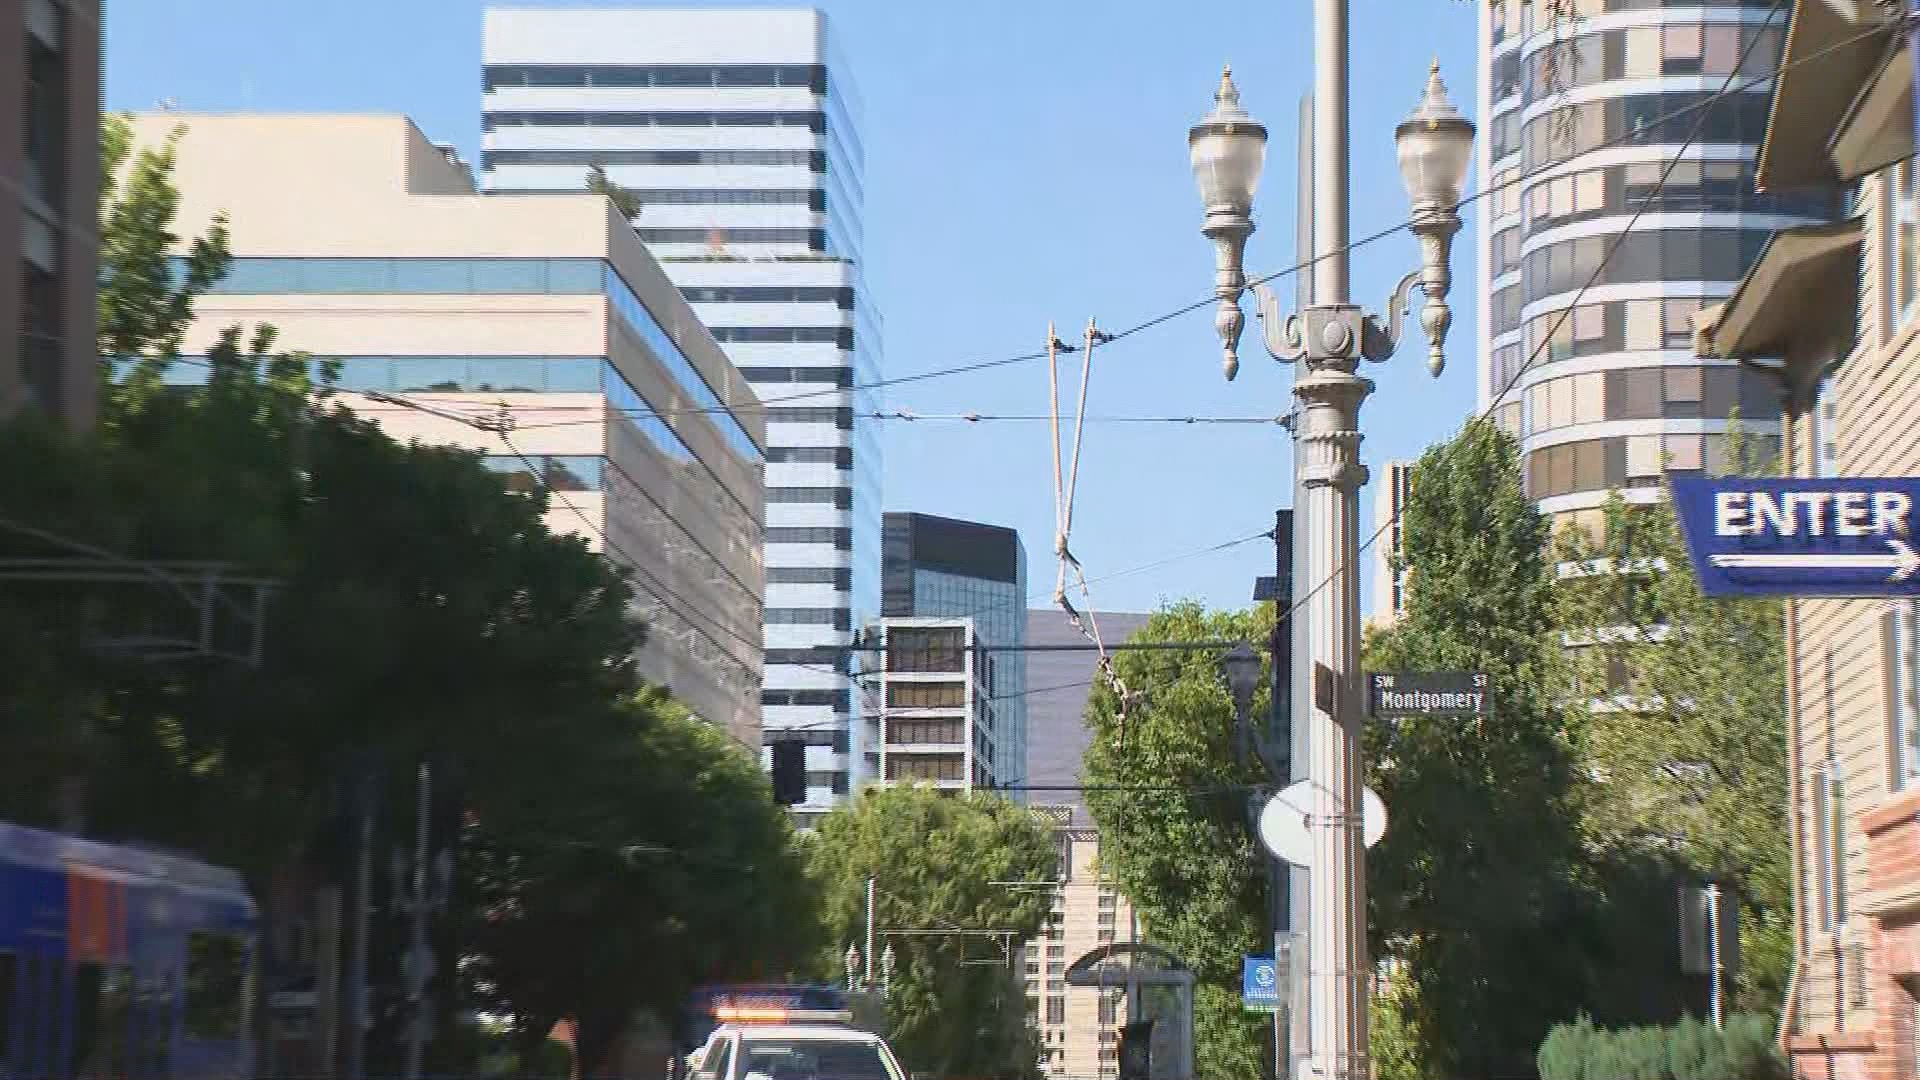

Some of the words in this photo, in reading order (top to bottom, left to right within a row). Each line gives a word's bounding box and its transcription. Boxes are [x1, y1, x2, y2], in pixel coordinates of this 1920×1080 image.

[1714, 491, 1913, 536] ENTER
[1375, 674, 1395, 689] SW
[1472, 674, 1489, 688] ST
[1381, 690, 1484, 714] Montgomery
